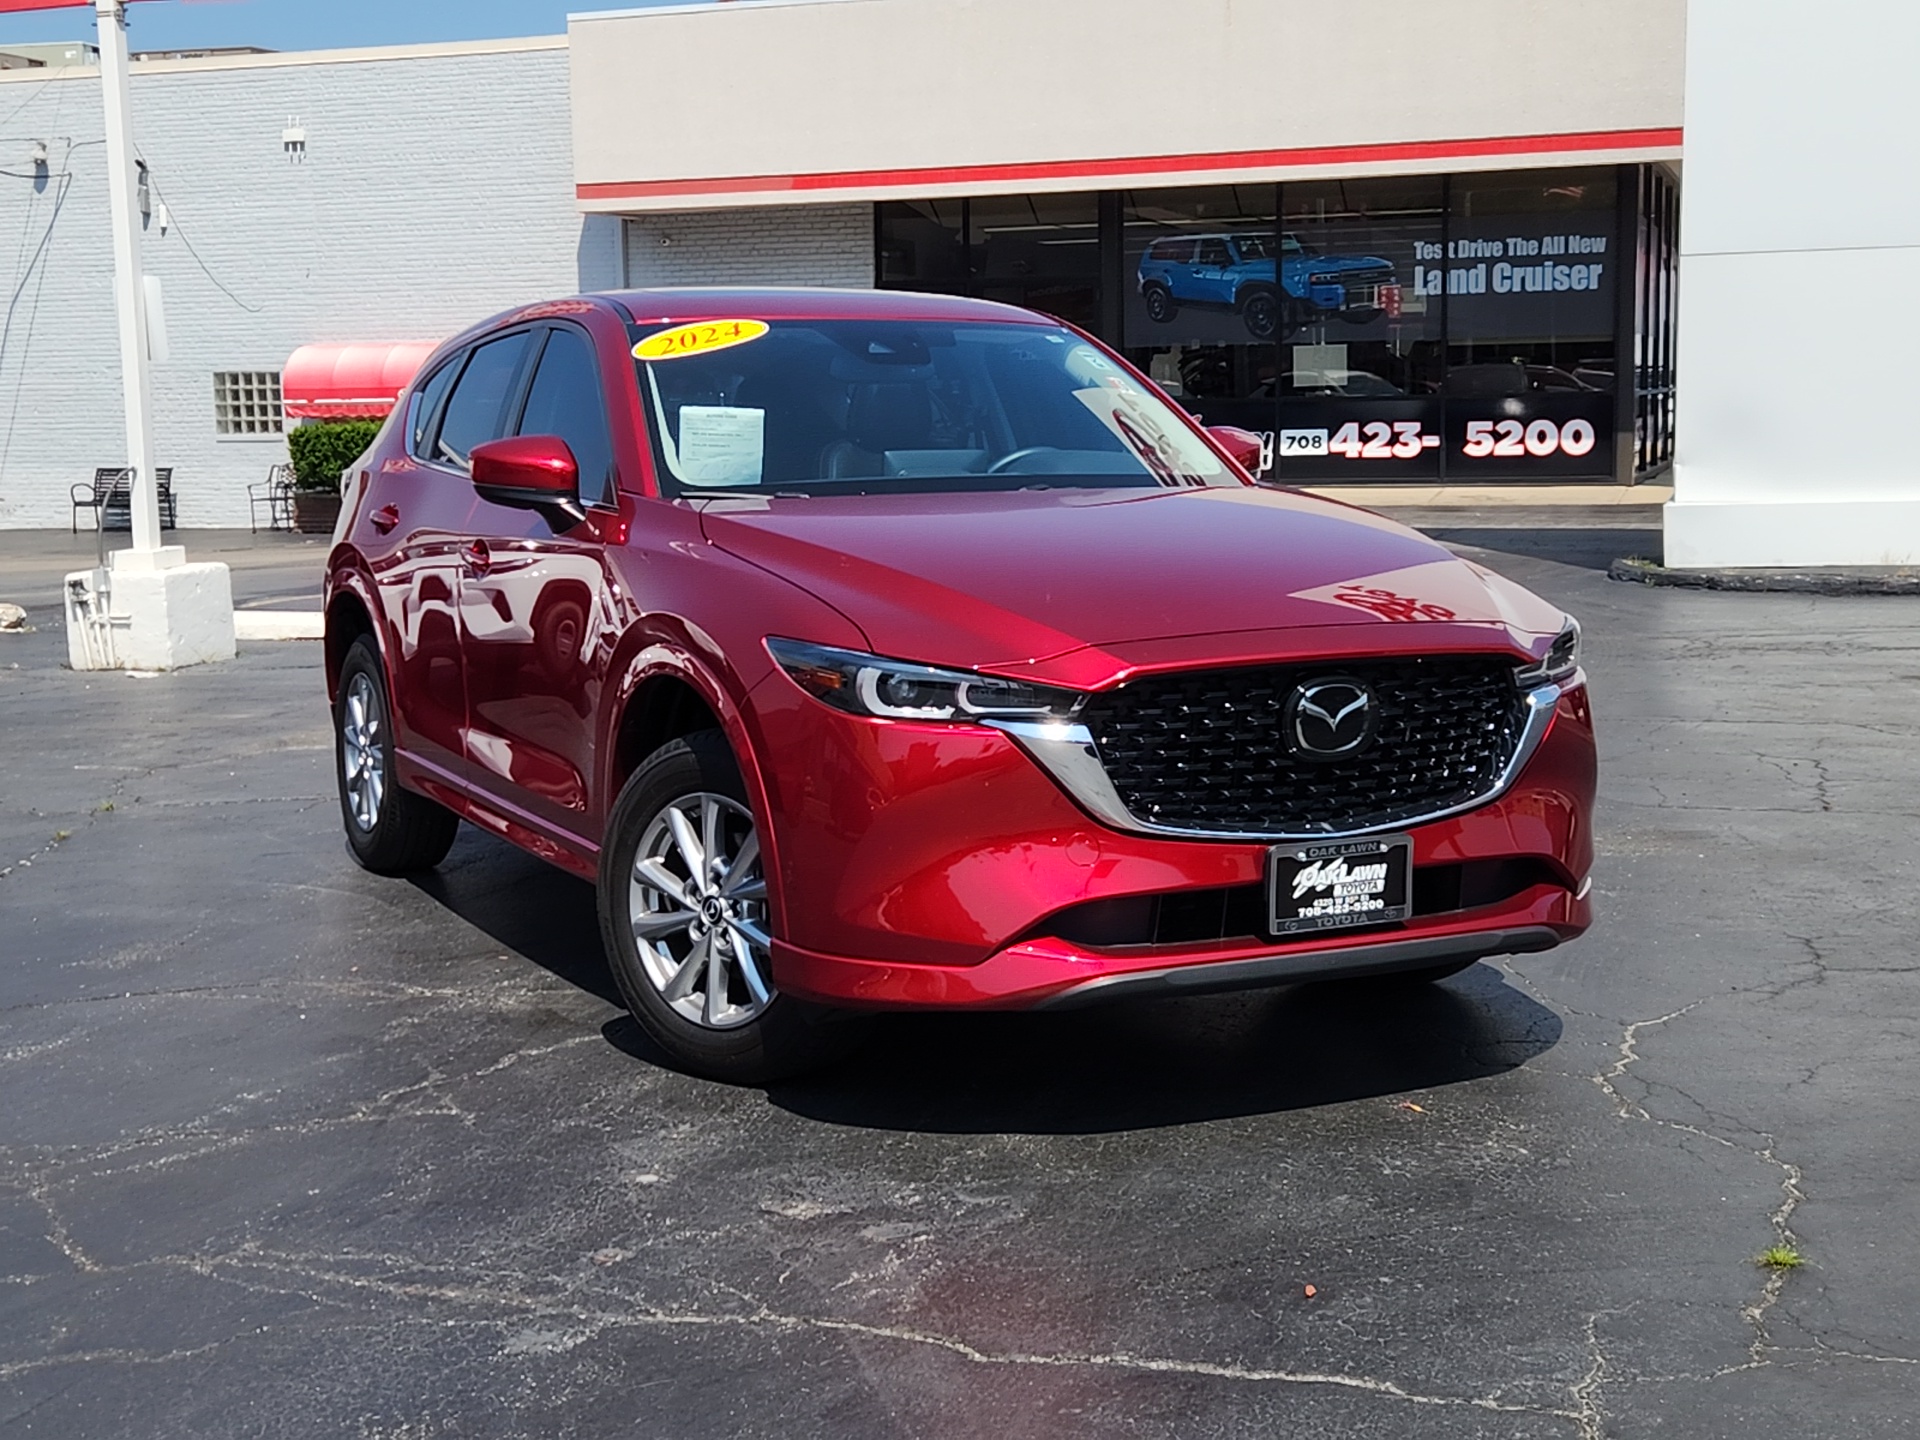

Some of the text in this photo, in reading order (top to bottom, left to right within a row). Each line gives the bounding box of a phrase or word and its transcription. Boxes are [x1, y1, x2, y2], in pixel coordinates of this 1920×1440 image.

[1413, 235, 1607, 260] Test Drive The All New
[1413, 261, 1603, 296] Land Cruiser
[659, 322, 742, 356] 2024
[1286, 435, 1322, 449] 708
[1462, 418, 1596, 458] 5200
[1309, 842, 1378, 857] OAK LAWN
[1340, 881, 1379, 894] TOYOTA
[1315, 914, 1369, 927] TOYOTA
